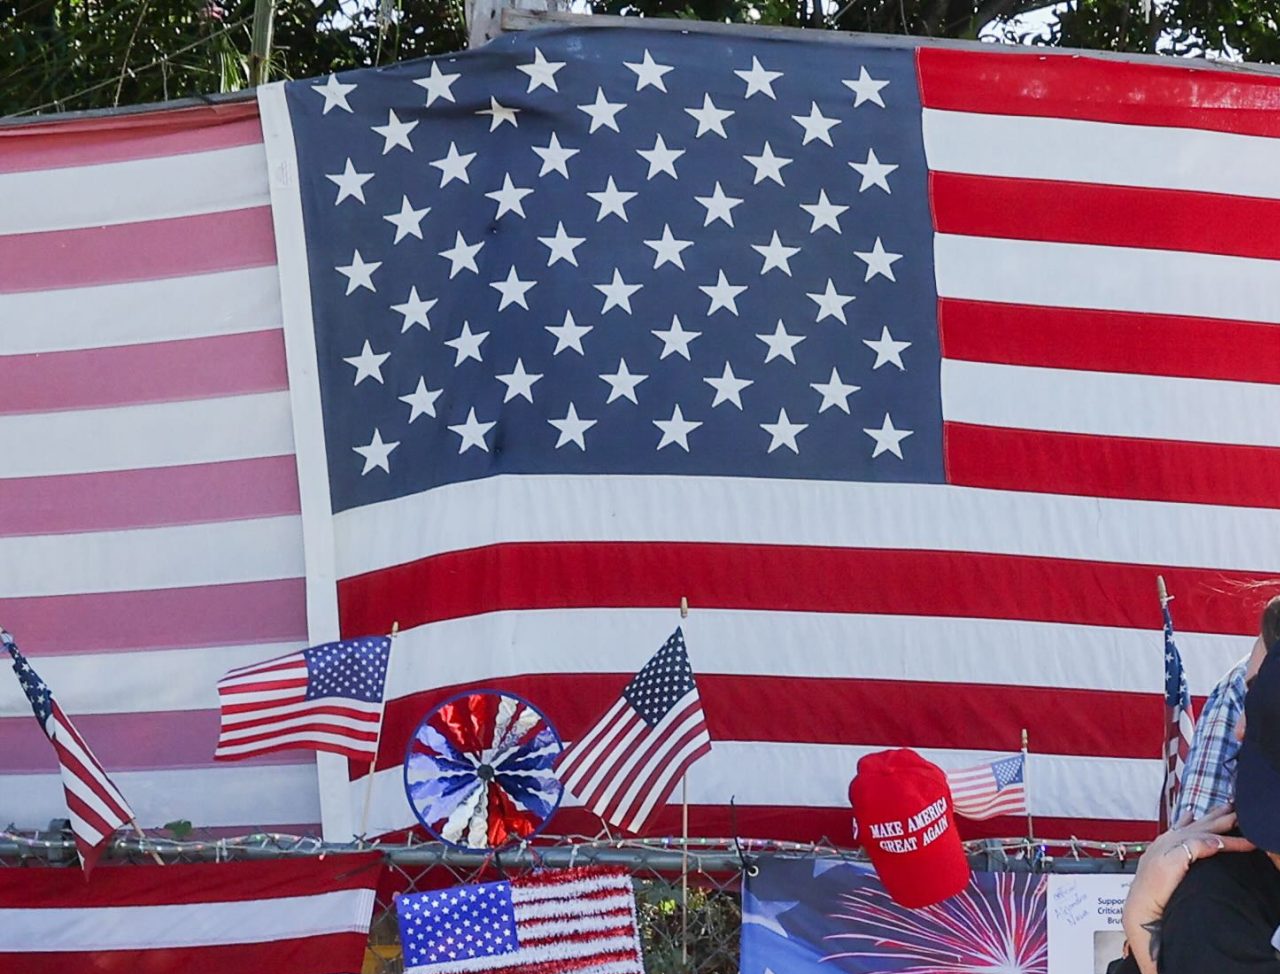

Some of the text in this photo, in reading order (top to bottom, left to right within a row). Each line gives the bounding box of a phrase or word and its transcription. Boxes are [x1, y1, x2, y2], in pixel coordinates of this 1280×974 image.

[869, 820, 905, 839] MAKE
[879, 814, 949, 853] GREAT AGAIN
[1097, 897, 1125, 906] Suppor
